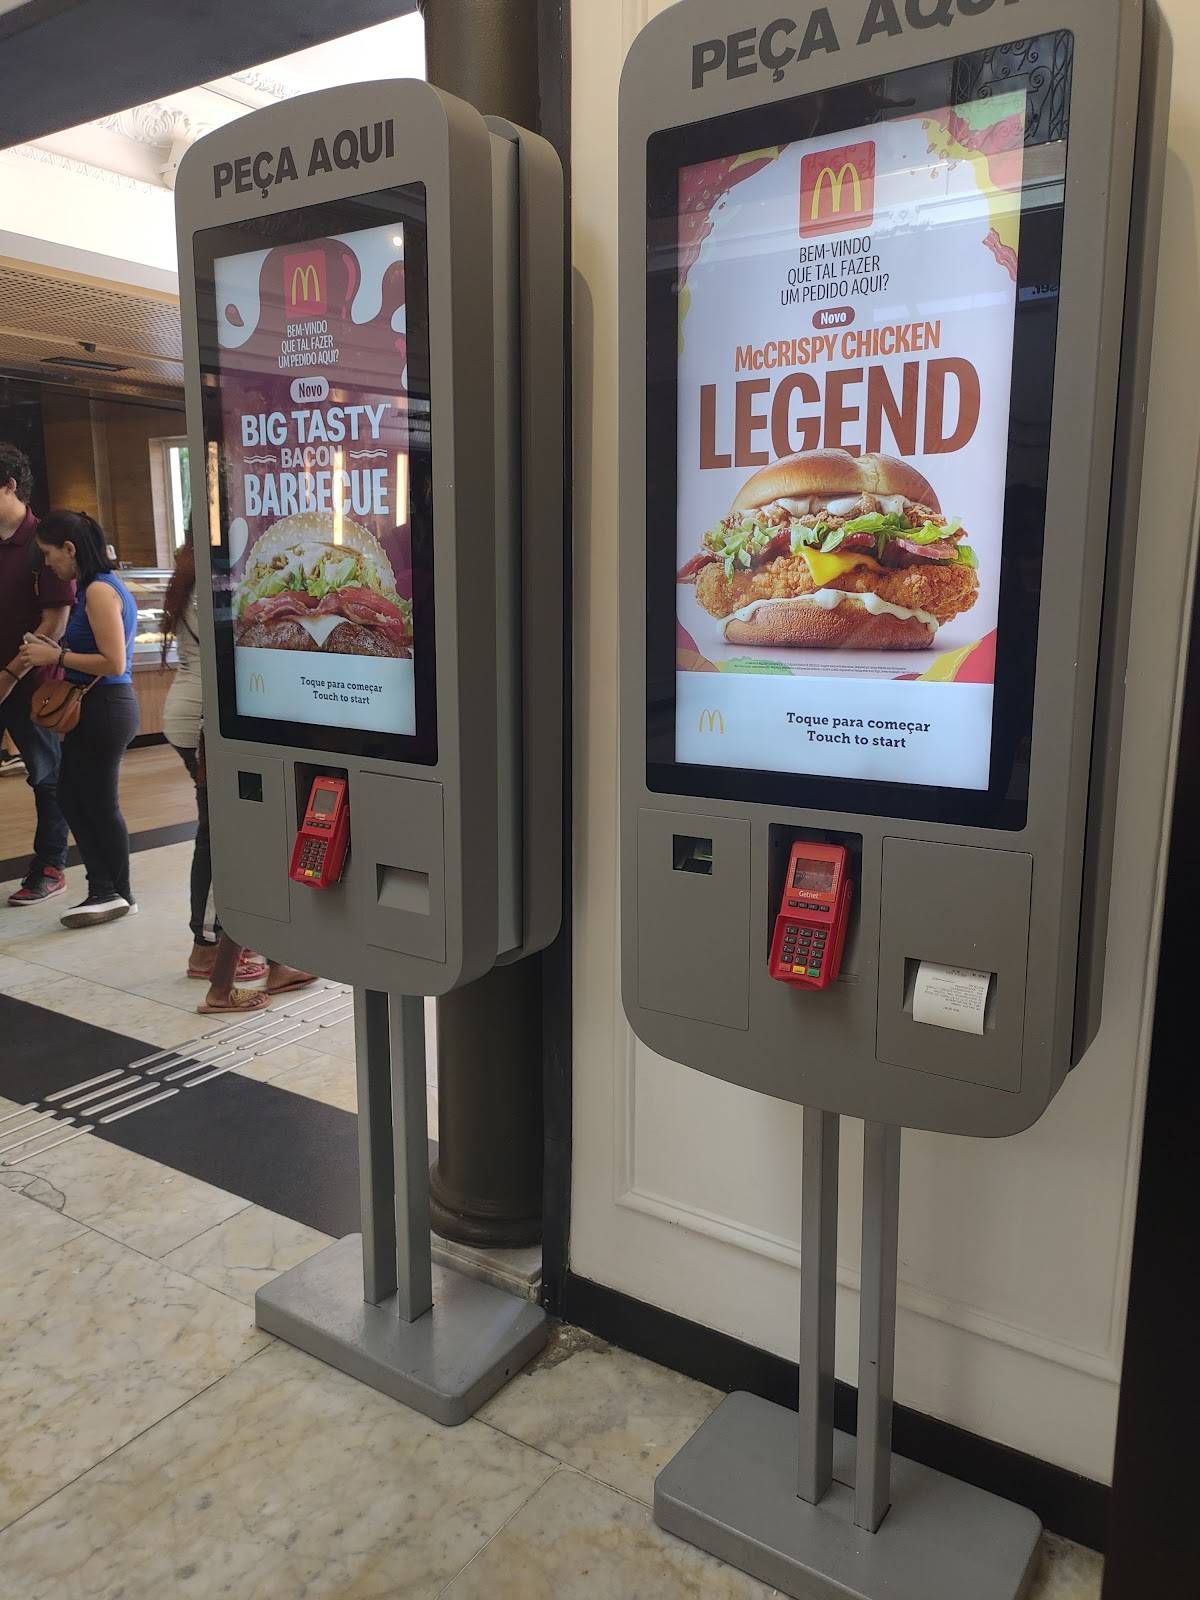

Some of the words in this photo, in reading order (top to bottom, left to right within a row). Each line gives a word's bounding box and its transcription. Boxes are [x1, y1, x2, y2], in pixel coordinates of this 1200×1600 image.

[691, 7, 841, 90] PEÇA
[856, 0, 1020, 46] AQ
[213, 146, 299, 199] PEÇA
[307, 119, 395, 176] AQUI
[800, 235, 872, 263] BEM-VINDO
[788, 266, 812, 287] QUE
[815, 262, 838, 281] TAL
[841, 255, 881, 277] FAZER
[780, 288, 800, 306] UM
[802, 280, 848, 303] PEDIDO
[851, 273, 890, 296] AQUI?
[287, 320, 328, 338] BEM-VINDO
[820, 312, 847, 326] Novo
[281, 338, 296, 353] QUE
[297, 338, 310, 352] TAL
[311, 335, 334, 350] FAZER
[735, 333, 838, 372] McCRISPY
[841, 320, 941, 360] CHICKEN
[278, 355, 290, 369] UM
[290, 351, 317, 368] PEDIDO
[318, 349, 340, 365] AQUI?
[298, 382, 323, 398] Novo
[699, 356, 981, 470] LEGEND
[241, 411, 288, 447] BIG
[281, 445, 343, 469] BACON
[244, 468, 390, 517] BARBECUE
[300, 676, 325, 688] Toque
[327, 681, 345, 690] para
[347, 682, 383, 694] começar
[313, 690, 339, 702] Touch
[340, 694, 349, 703] to
[350, 695, 370, 704] start
[786, 711, 829, 727] Toque
[832, 716, 864, 729] para
[867, 719, 931, 734] começar
[807, 730, 851, 745] Touch
[854, 734, 869, 746] to
[872, 736, 906, 748] start
[798, 889, 819, 900] Getnet
